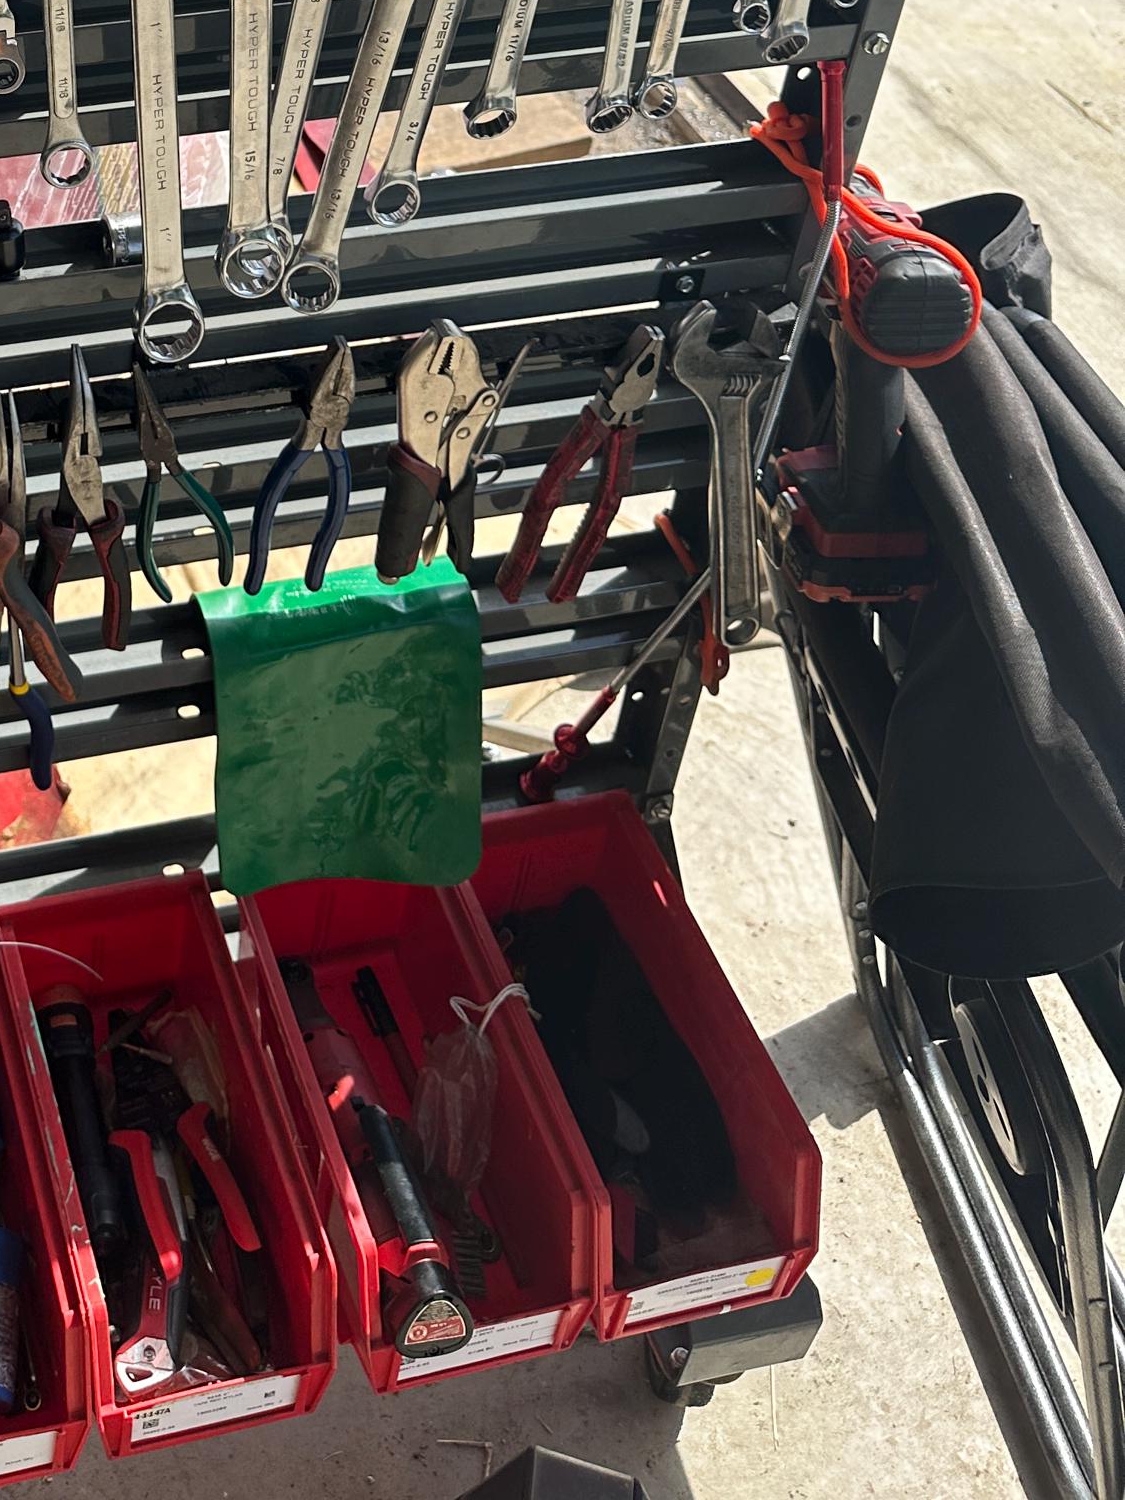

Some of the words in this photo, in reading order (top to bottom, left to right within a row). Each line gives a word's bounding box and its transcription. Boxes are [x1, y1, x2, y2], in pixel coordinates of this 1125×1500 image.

[247, 12, 259, 73] HYPER
[371, 30, 392, 67] 13/16
[434, 1, 456, 50] HYPER
[504, 33, 520, 62] 11/16
[295, 28, 313, 80] HYPER
[418, 54, 442, 101] TOUGH
[152, 73, 165, 130] HYPER
[247, 77, 259, 132] TOUGH
[282, 87, 301, 134] TOUGH
[354, 76, 377, 127] HYPER
[338, 129, 360, 179] TOUGH
[405, 120, 420, 142] 3/4
[156, 135, 167, 191] TOUGH
[245, 150, 256, 181] 15/16
[273, 155, 286, 176] 7/8
[324, 188, 342, 220] 13/16
